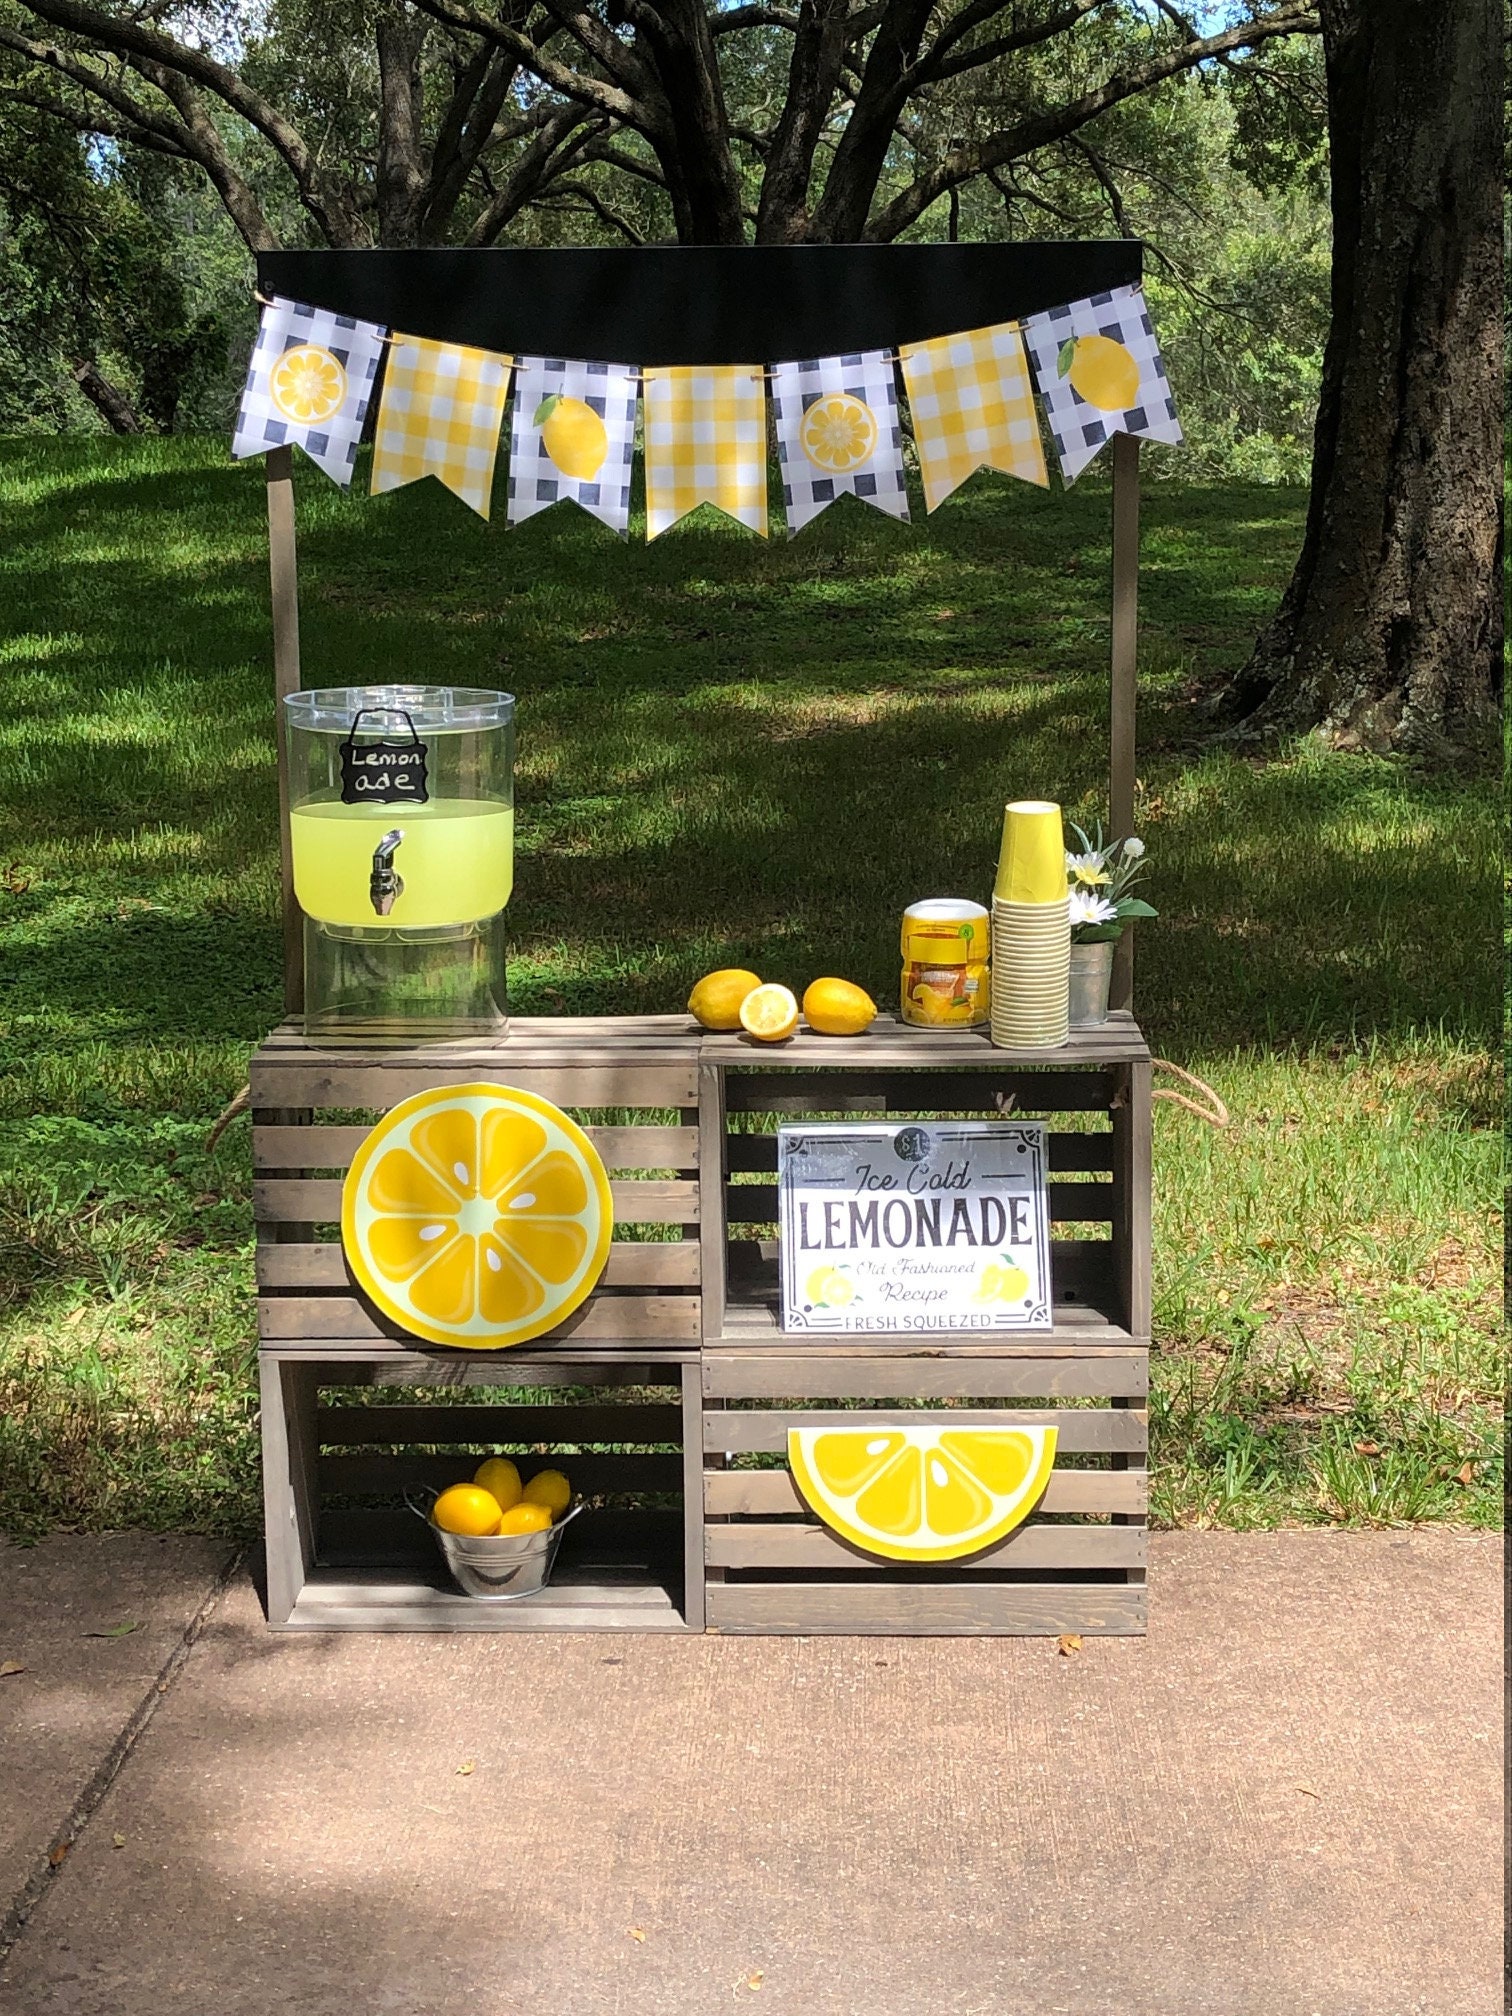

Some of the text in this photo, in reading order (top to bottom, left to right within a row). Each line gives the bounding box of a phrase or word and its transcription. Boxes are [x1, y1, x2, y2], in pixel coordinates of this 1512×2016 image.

[352, 749, 422, 766] Lemon
[355, 772, 416, 791] ade
[855, 1161, 972, 1196] Ice Cold
[799, 1196, 1033, 1250] LEMONADE
[892, 1257, 976, 1275] Fashioned
[879, 1282, 948, 1305] Recipe
[845, 1314, 991, 1330] FRESH SQUEEZED
